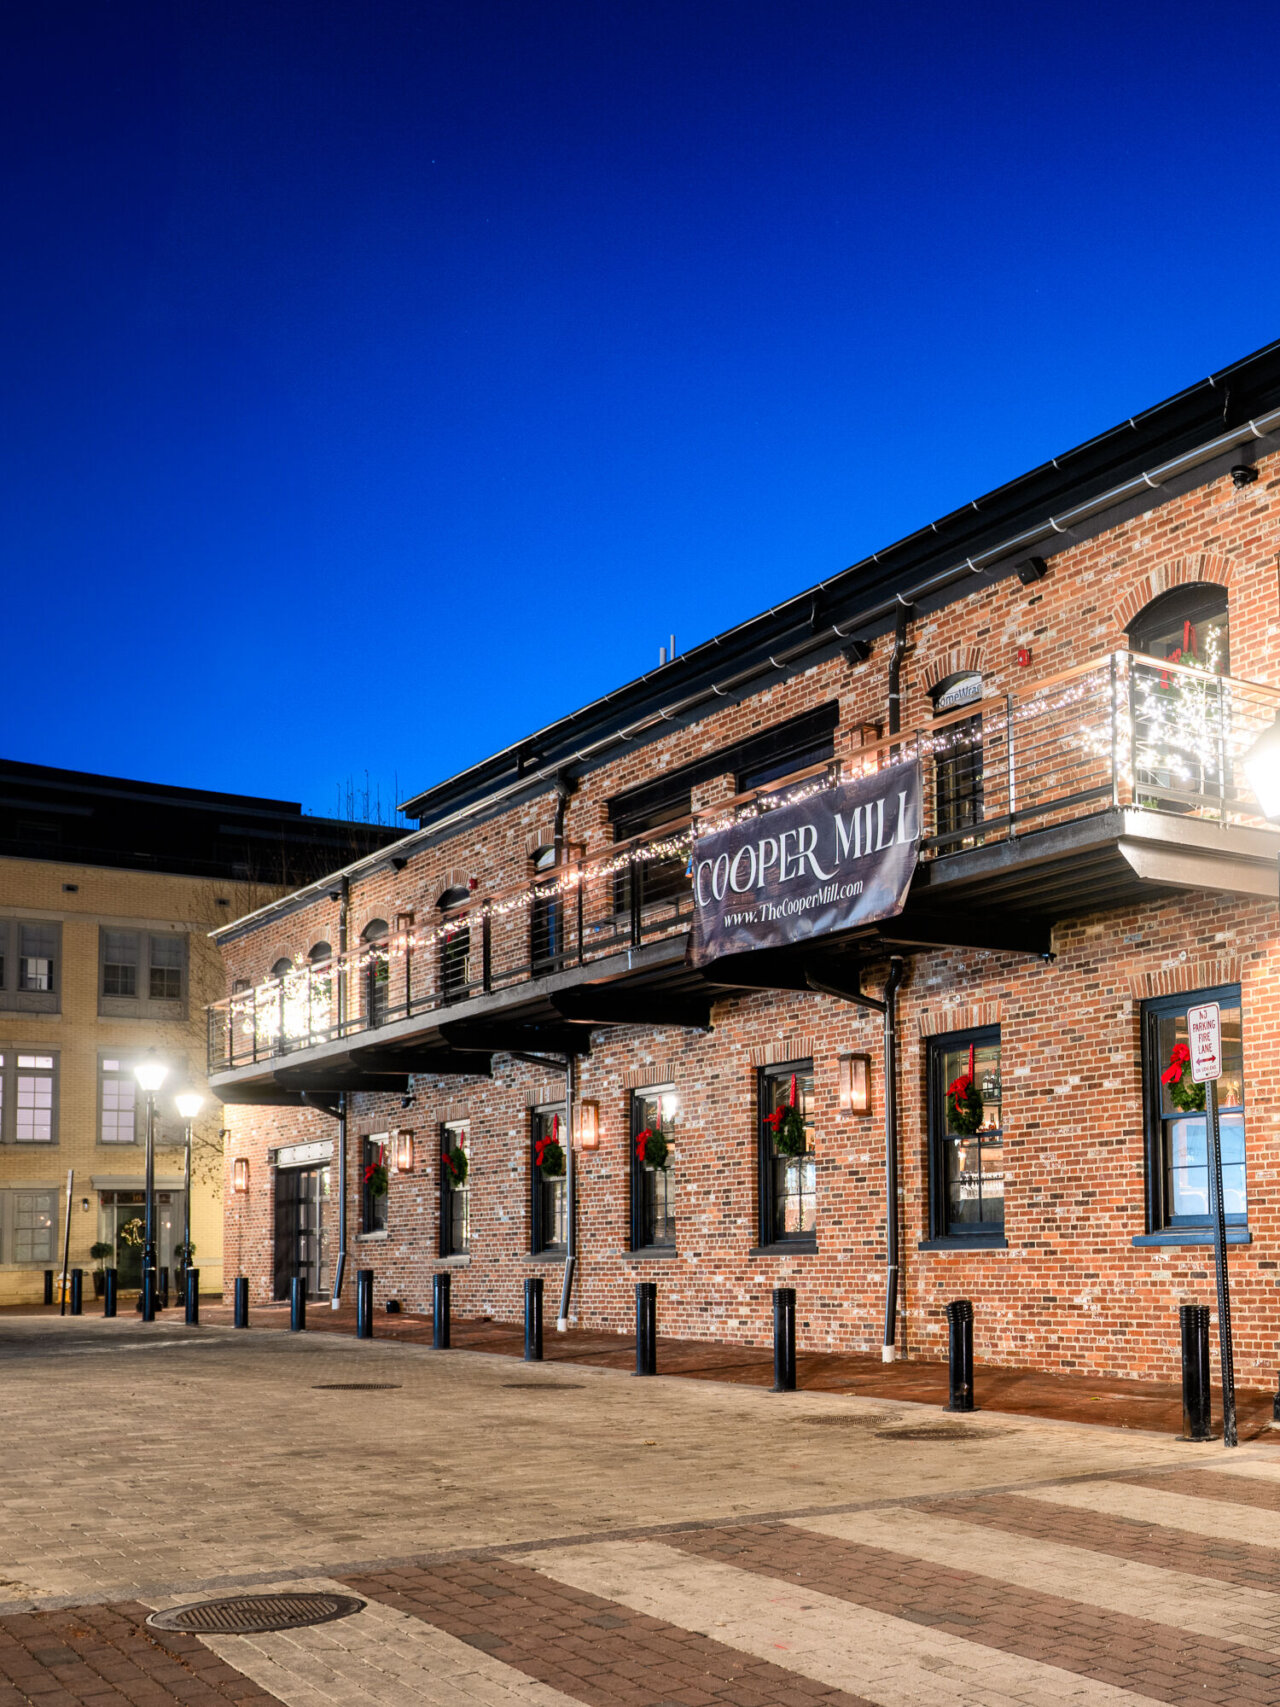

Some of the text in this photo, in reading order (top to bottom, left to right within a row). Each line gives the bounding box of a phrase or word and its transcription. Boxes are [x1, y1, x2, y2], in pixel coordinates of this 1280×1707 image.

[697, 791, 920, 907] COOPER MILL
[724, 880, 864, 928] www.TheCooperMill.com
[1199, 1010, 1208, 1020] NO
[1193, 1020, 1215, 1032] PARKING
[1198, 1032, 1211, 1043] FIRE
[1198, 1043, 1213, 1055] LANE
